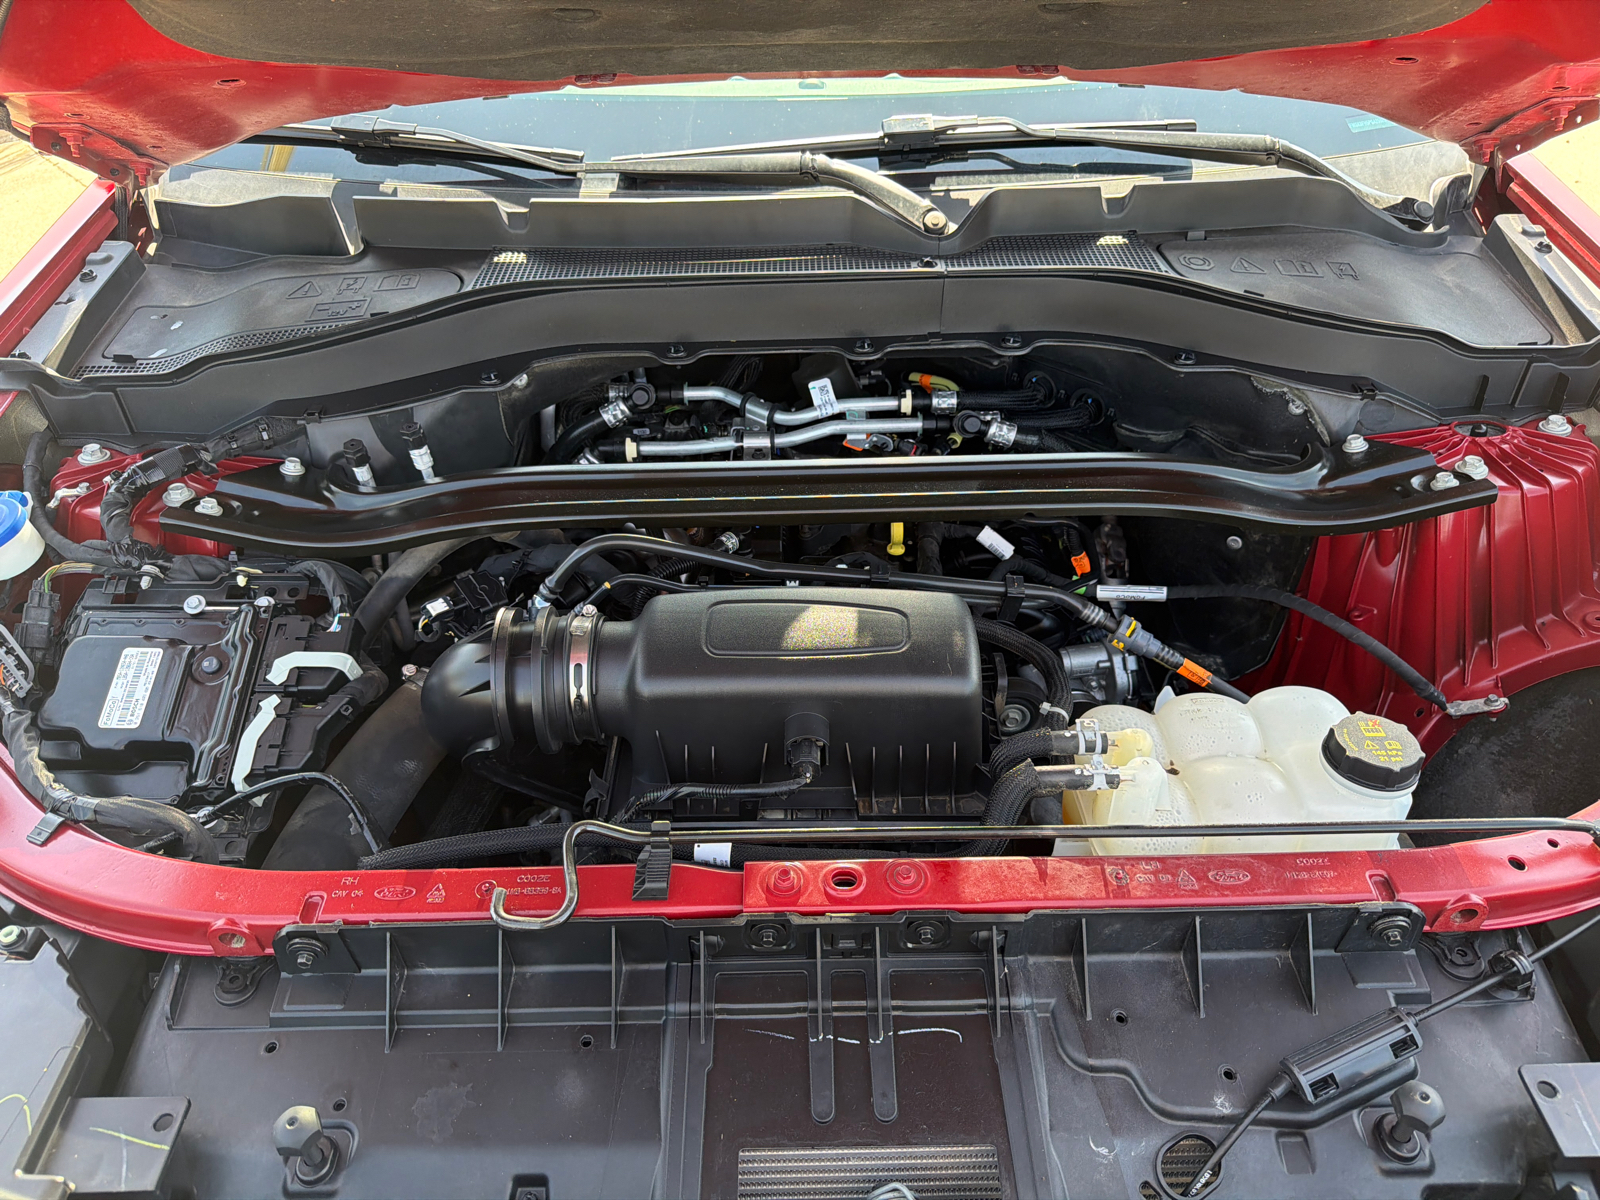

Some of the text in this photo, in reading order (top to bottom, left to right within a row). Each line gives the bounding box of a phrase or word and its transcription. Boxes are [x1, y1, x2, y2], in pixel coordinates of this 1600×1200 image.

[103, 700, 116, 724] FoMoCo
[130, 698, 140, 716] BOSCH
[341, 876, 359, 886] RH
